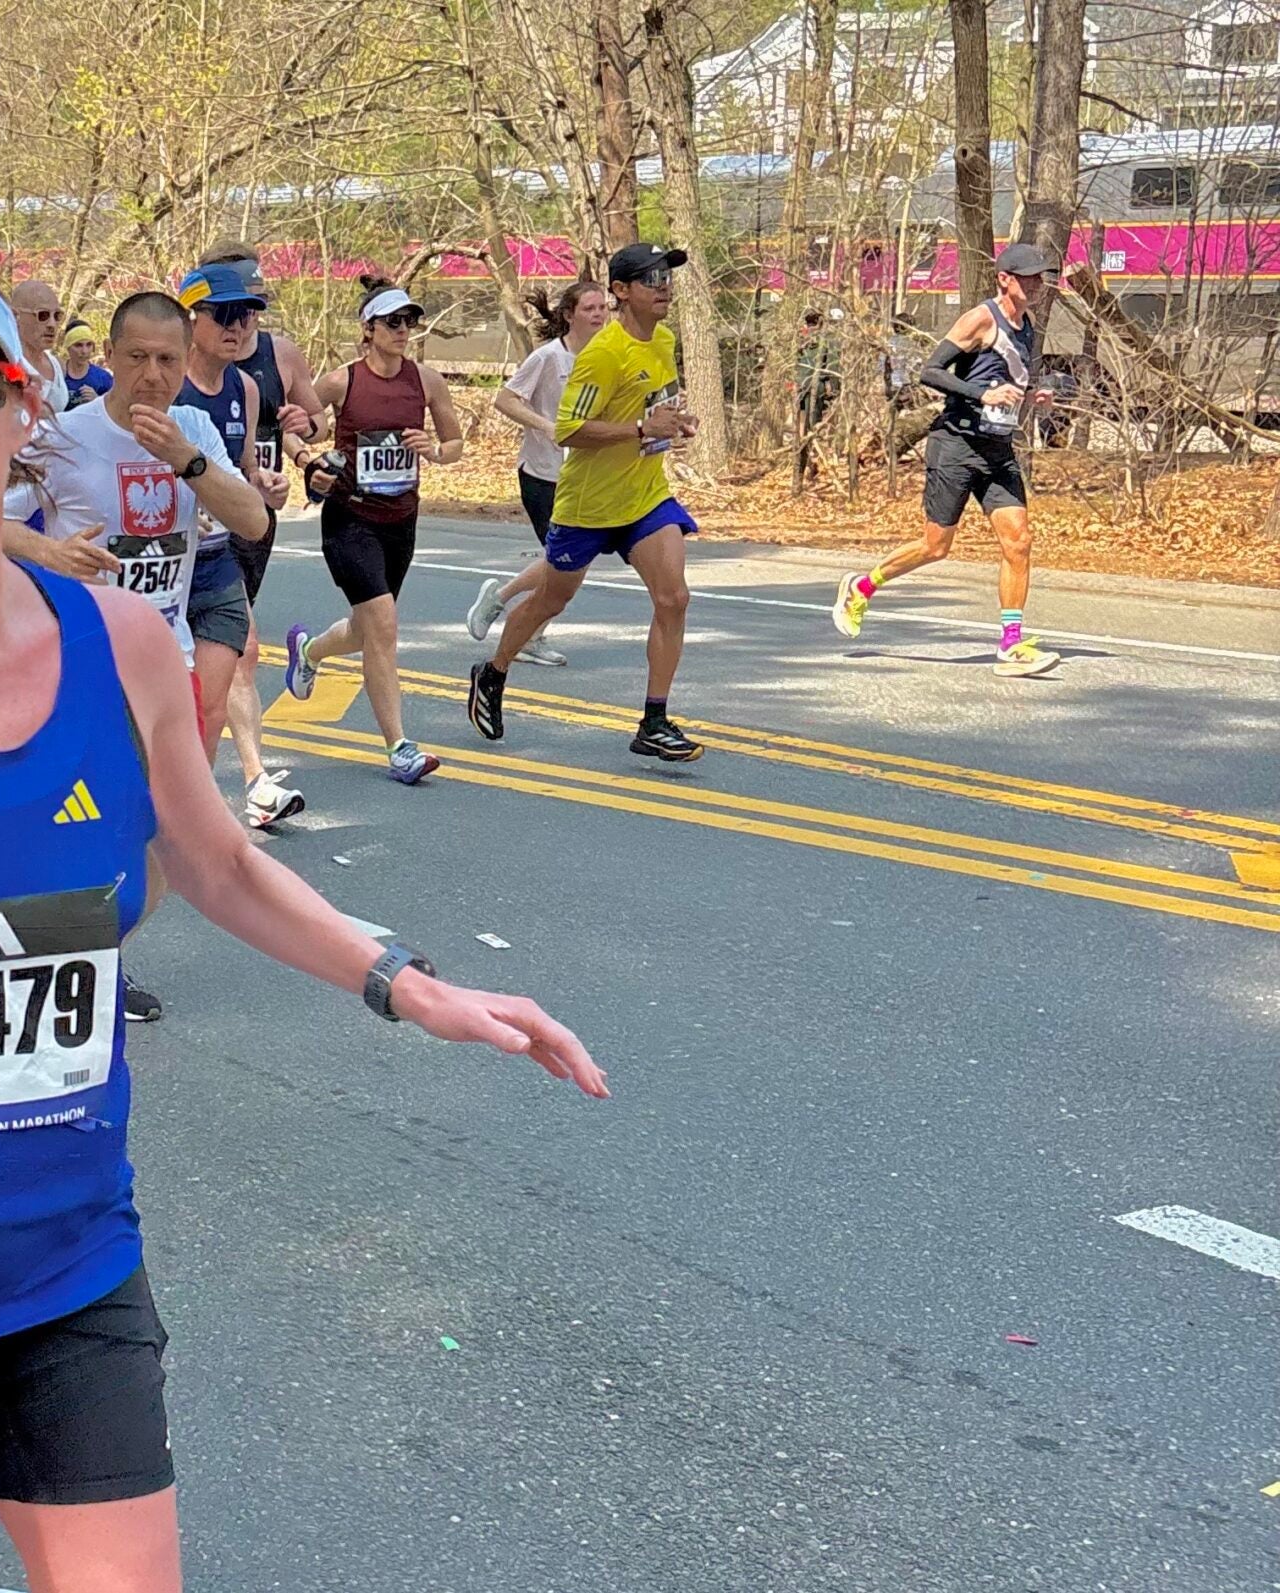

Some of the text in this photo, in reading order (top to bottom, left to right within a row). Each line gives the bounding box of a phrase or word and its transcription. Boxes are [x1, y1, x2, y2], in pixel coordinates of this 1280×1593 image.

[363, 448, 415, 472] 16020
[116, 557, 182, 595] 12547
[12, 1106, 86, 1129] MARATHON
